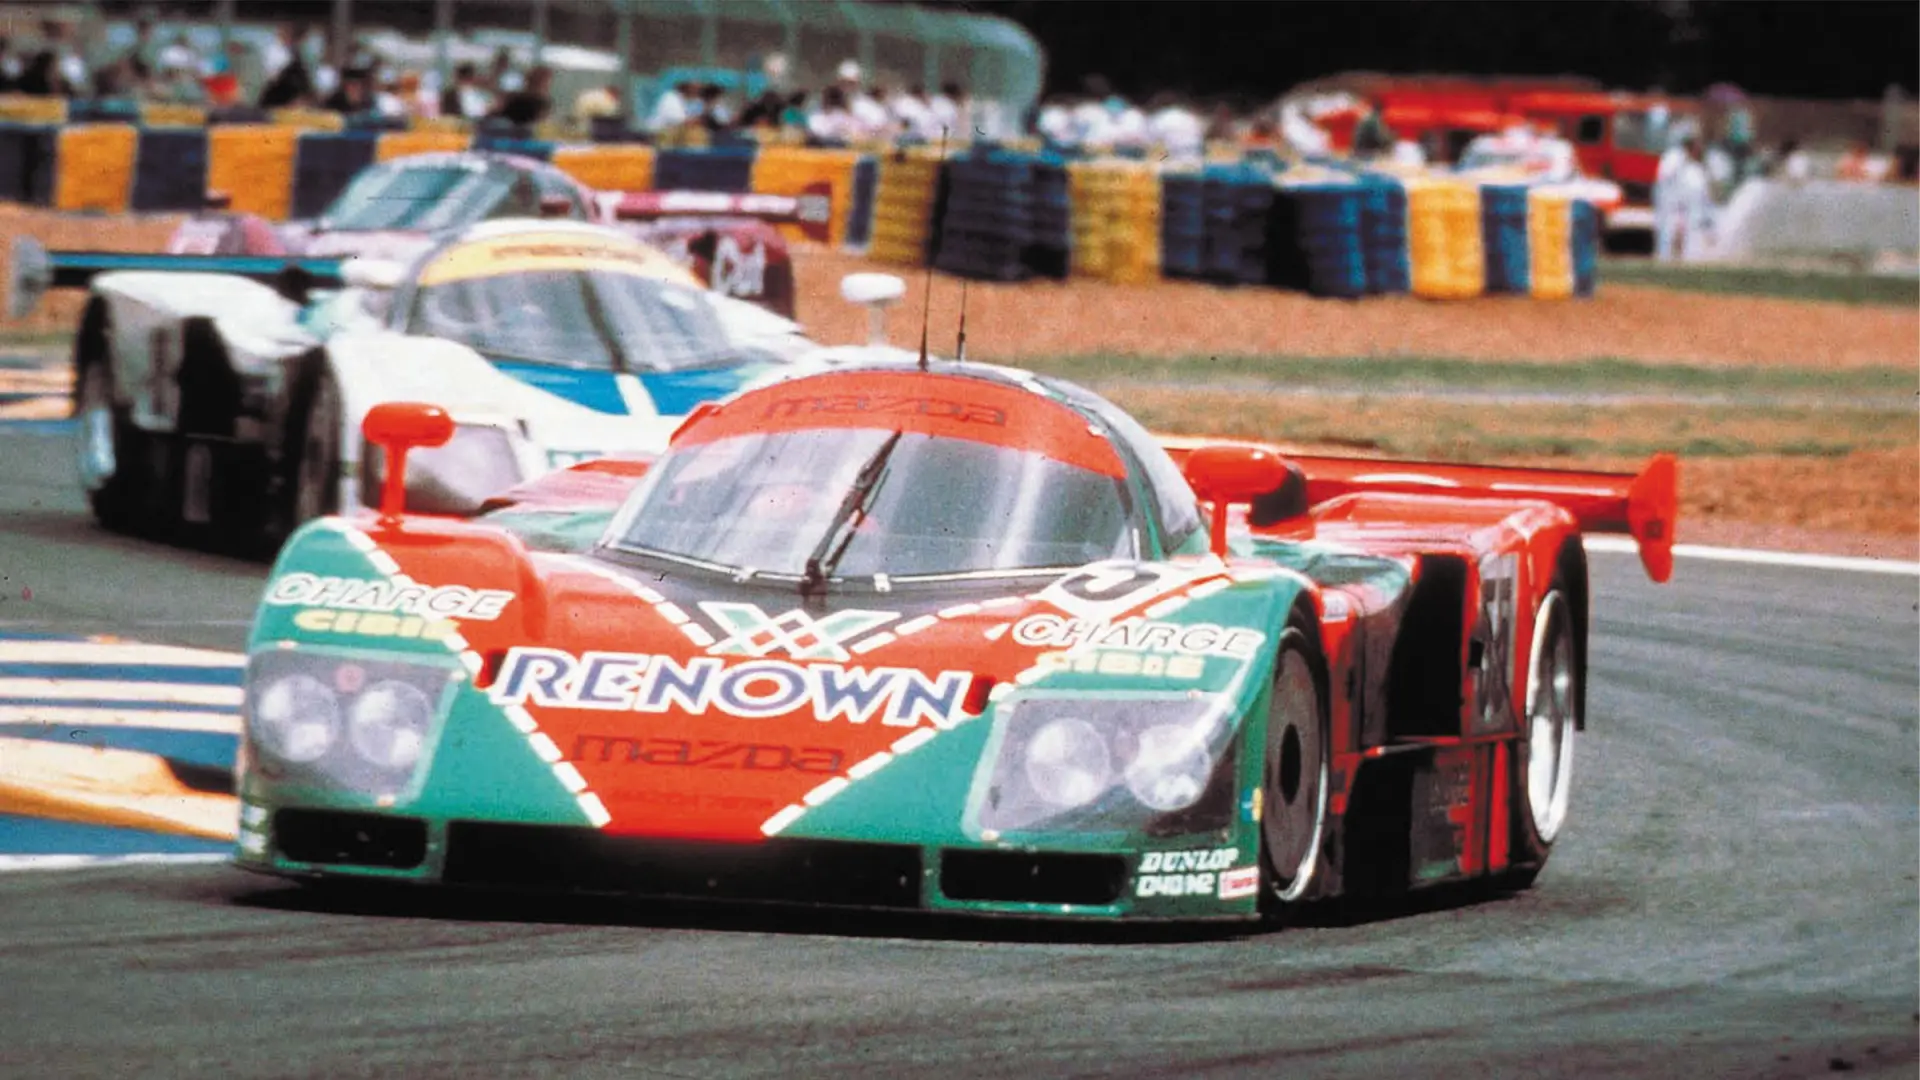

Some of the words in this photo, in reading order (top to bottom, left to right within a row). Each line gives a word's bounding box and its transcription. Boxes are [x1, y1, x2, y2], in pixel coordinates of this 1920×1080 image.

[266, 572, 516, 620] CHARGE
[1012, 614, 1266, 660] CHARGE
[489, 646, 973, 730] RENOWN
[1138, 847, 1239, 873] DUNLOP
